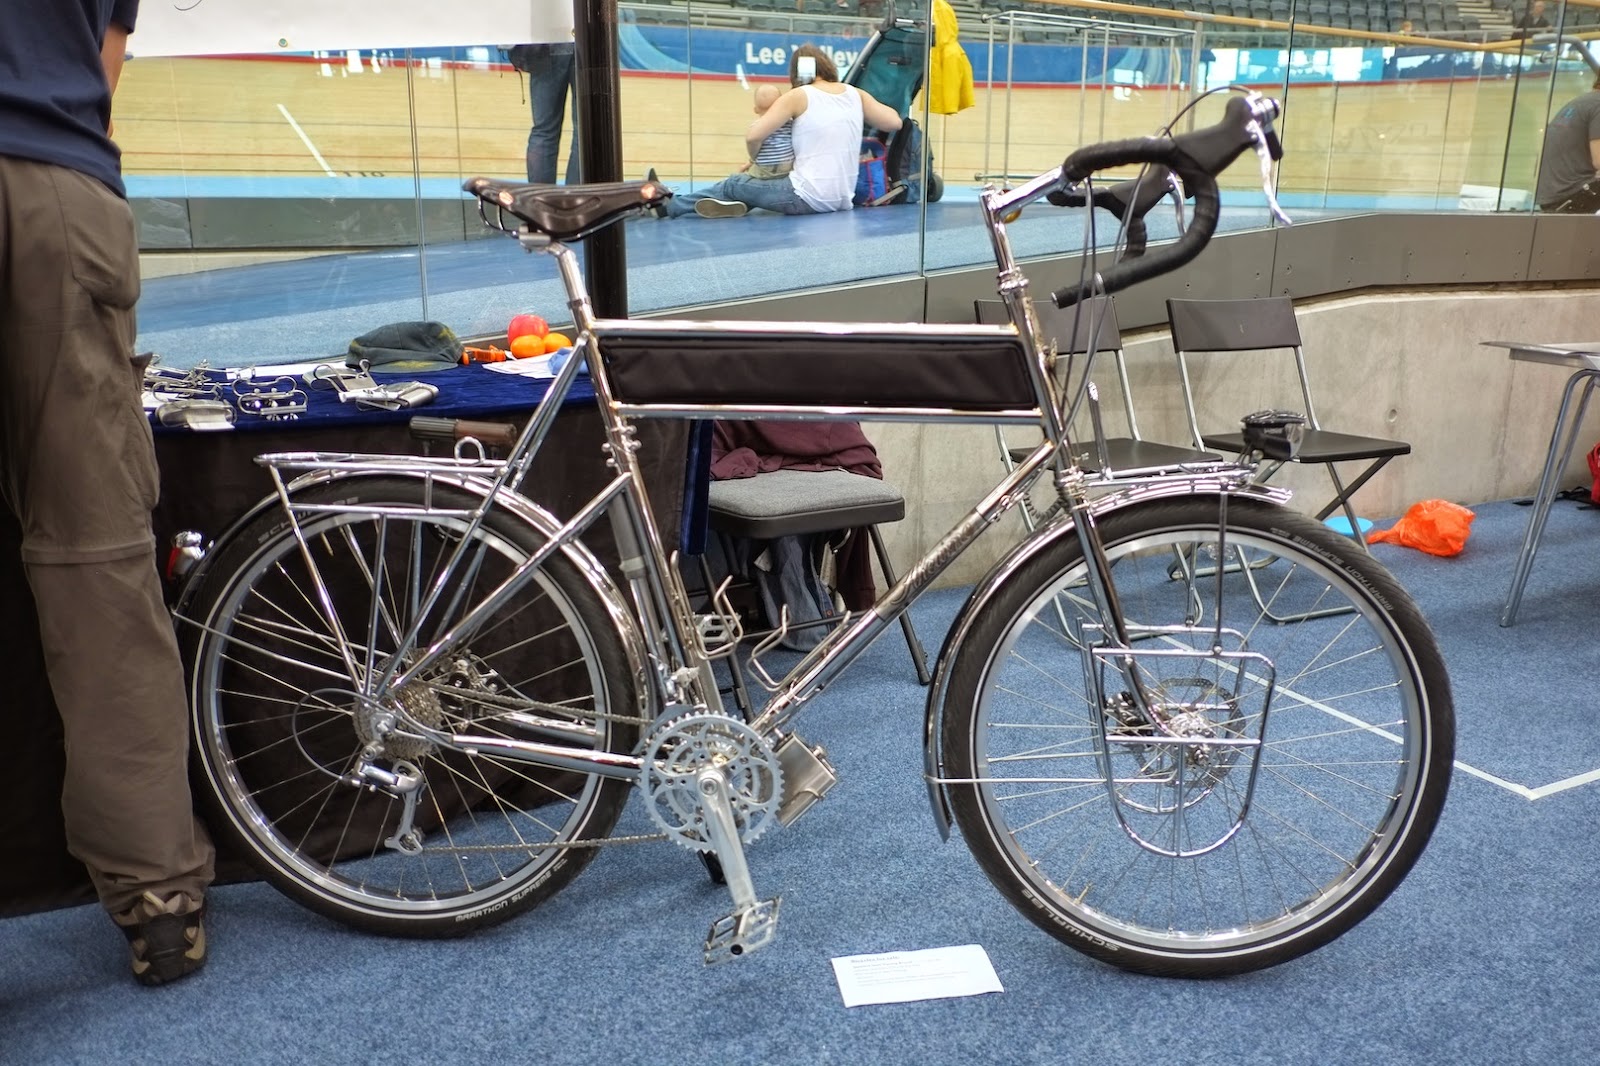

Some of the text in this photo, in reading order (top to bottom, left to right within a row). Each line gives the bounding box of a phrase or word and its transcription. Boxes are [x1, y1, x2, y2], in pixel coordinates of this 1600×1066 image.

[745, 42, 786, 65] Lee
[455, 870, 553, 923] MARATHON SUPREME
[1021, 887, 1120, 952] SCHWALBE
